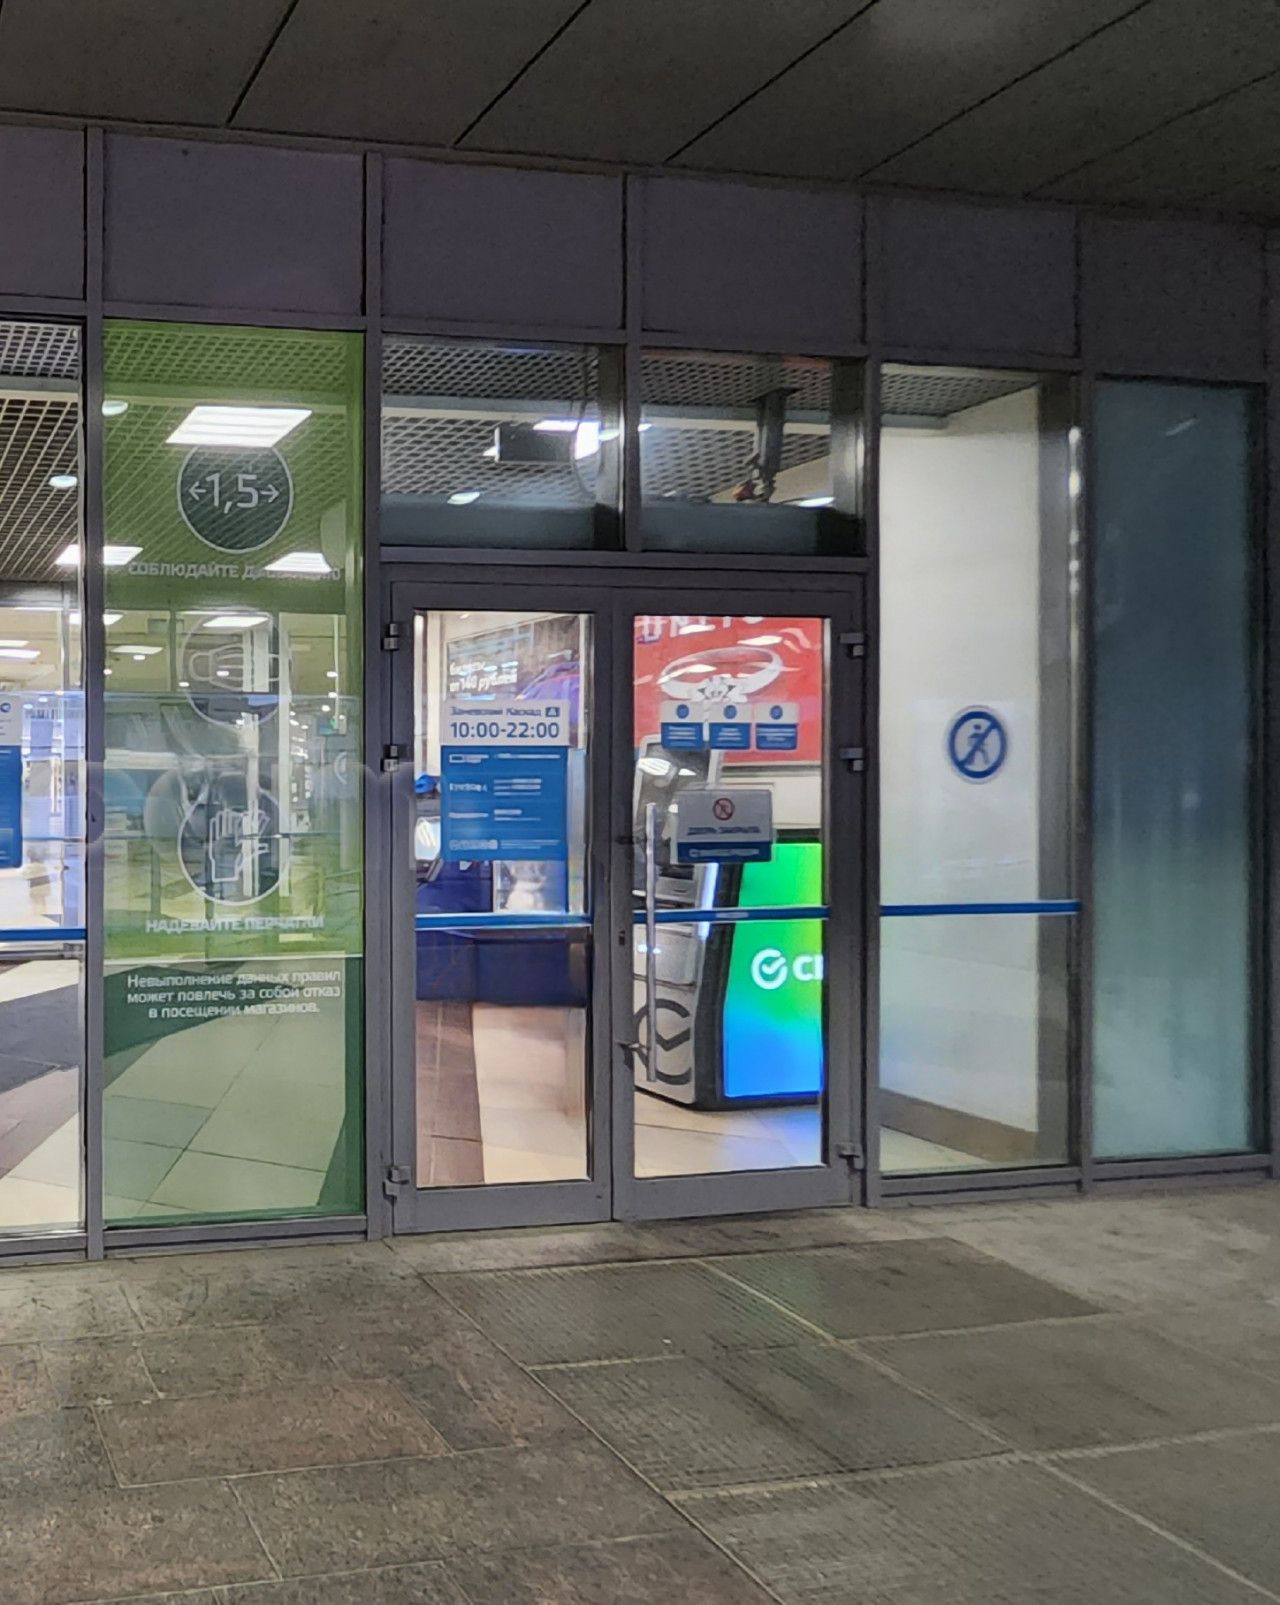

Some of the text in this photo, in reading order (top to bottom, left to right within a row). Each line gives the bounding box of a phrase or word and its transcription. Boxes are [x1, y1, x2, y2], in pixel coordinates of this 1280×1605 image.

[205, 473, 259, 514] 1,5
[128, 561, 240, 580] СОБЛЮДАЙТЕ
[450, 722, 559, 739] 10:00-22:00
[145, 918, 243, 935] НАДЕВАЙТЕ
[127, 974, 234, 989] Невыполнение
[291, 971, 341, 985] правил
[127, 991, 175, 1004] может
[178, 989, 236, 1002] повлечь
[240, 988, 256, 999] за
[303, 985, 341, 998] отказ
[148, 1007, 158, 1018] в
[161, 1005, 241, 1019] посещении
